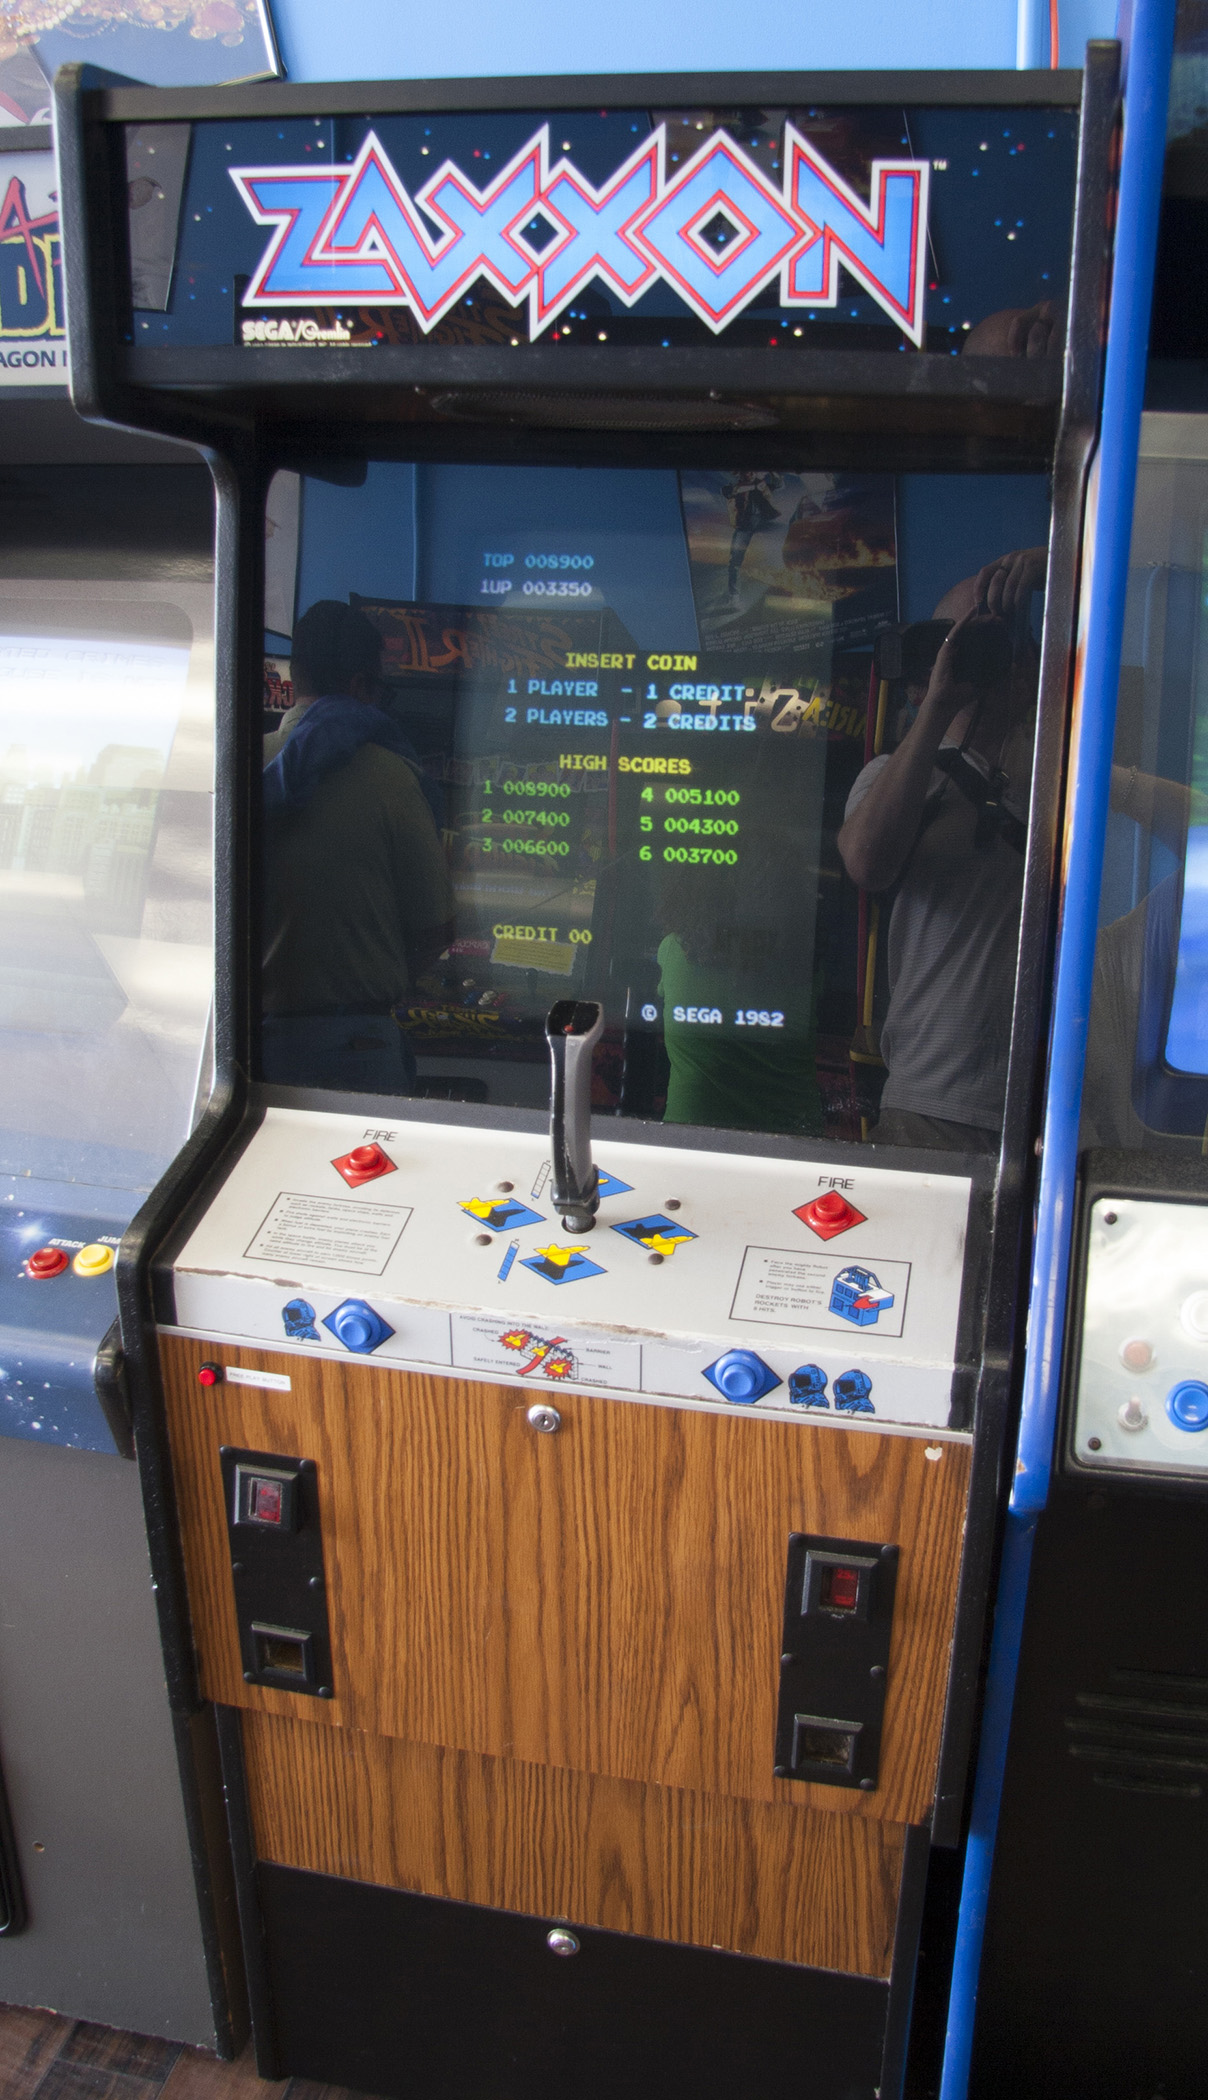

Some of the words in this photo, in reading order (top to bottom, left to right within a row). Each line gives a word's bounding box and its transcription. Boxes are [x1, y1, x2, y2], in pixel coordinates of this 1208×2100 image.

[229, 121, 930, 348] ZAXXON
[483, 553, 514, 569] TOP
[525, 554, 594, 570] 008900
[480, 580, 512, 595] 1UP
[522, 581, 592, 597] 003350
[565, 652, 636, 670] INSERT
[647, 654, 697, 671] COIN
[507, 679, 517, 694] 1
[528, 679, 598, 697] PLAYER
[646, 684, 658, 700] 1
[669, 684, 745, 702] CREDIT
[505, 707, 517, 723] 2
[527, 709, 608, 727] PLAYERS
[643, 713, 657, 729] 2
[668, 714, 756, 732] CREDITS
[559, 754, 607, 771] HIGH
[618, 757, 692, 775] SCORES
[483, 780, 493, 794] 1
[503, 781, 571, 798] 008900
[641, 787, 654, 802] 4
[665, 789, 740, 806] 005100
[482, 809, 493, 824] 2
[503, 810, 570, 827] 007400
[640, 816, 653, 832] 5
[664, 818, 739, 836] 004300
[482, 837, 493, 852] 3
[503, 838, 570, 855] 006600
[639, 846, 652, 861] 6
[663, 847, 738, 865] 003700
[492, 925, 557, 942] CREDIT
[569, 928, 592, 945] 00
[673, 1007, 723, 1024] SEGA
[735, 1009, 785, 1027] 1982
[362, 1129, 399, 1142] FIRE
[817, 1175, 855, 1190] FIRE
[48, 1238, 86, 1249] ATTACK
[97, 1235, 122, 1245] JUM
[755, 1293, 789, 1301] DESTROY
